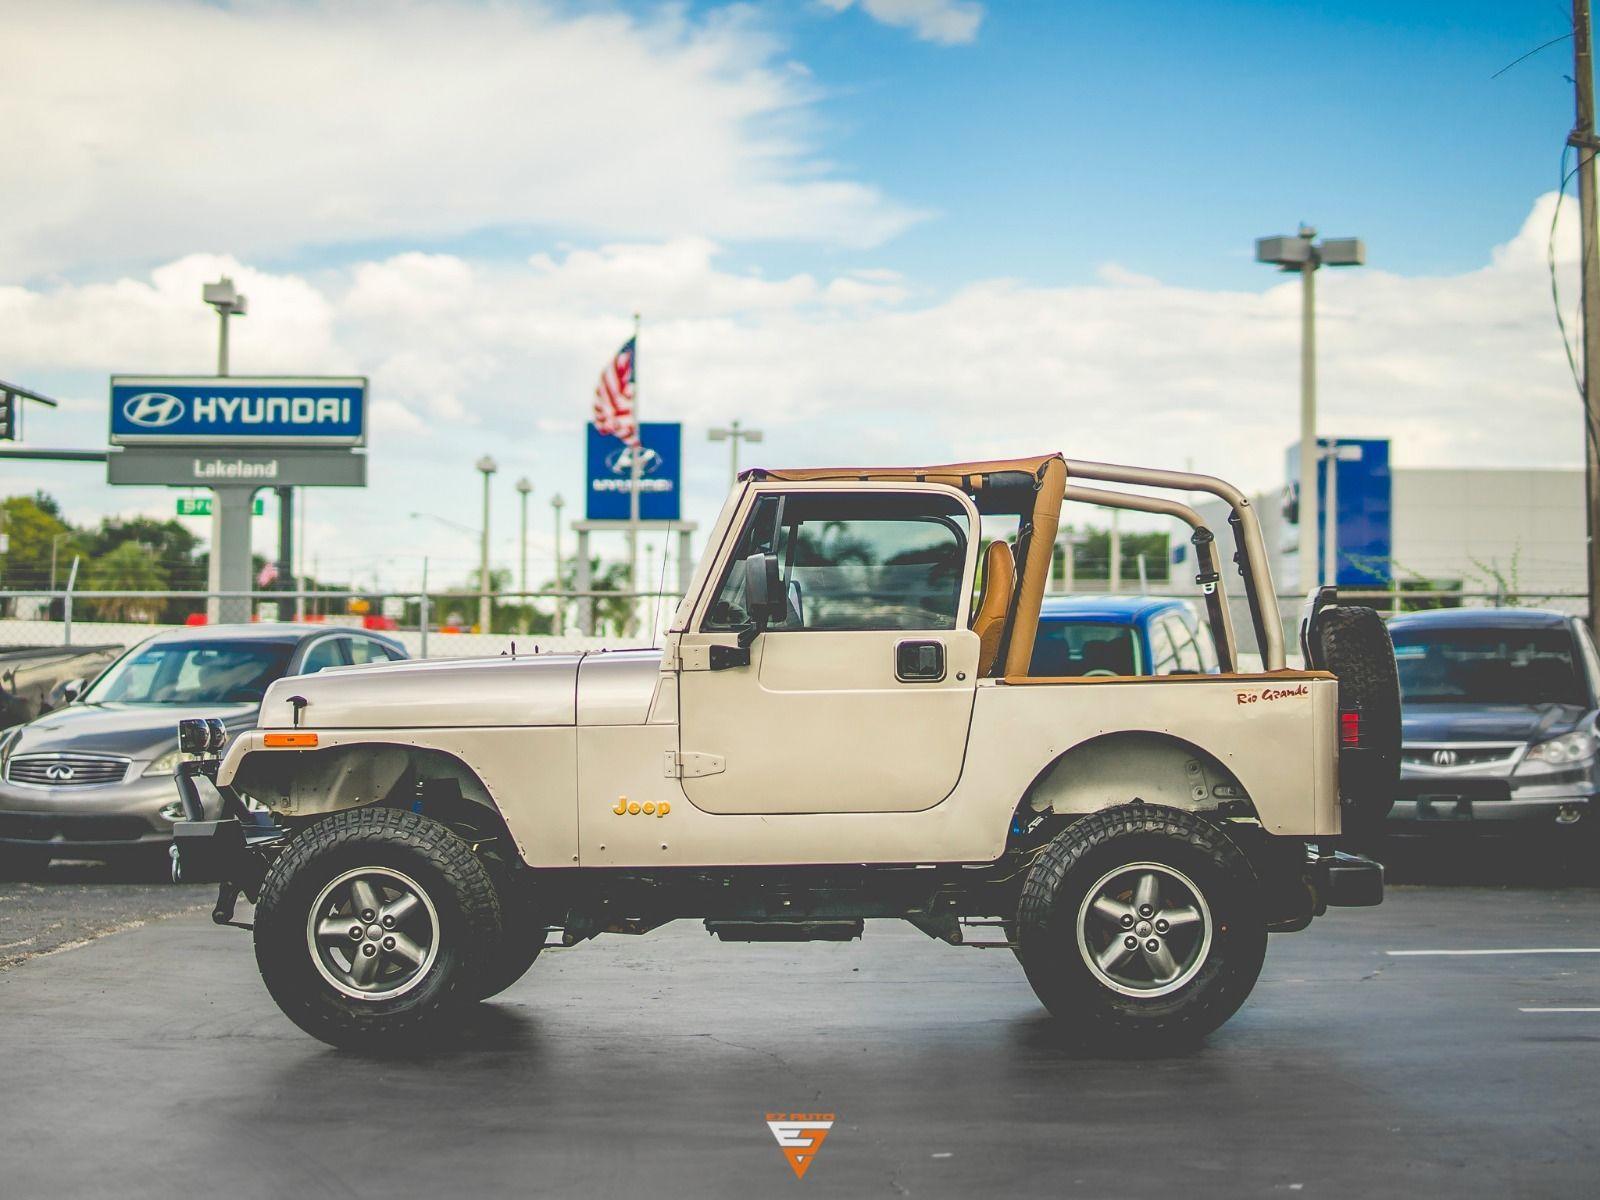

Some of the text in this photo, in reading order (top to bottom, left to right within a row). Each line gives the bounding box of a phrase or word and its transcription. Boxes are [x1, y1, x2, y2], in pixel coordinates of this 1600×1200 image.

[193, 397, 350, 424] HYUNDAI
[193, 459, 278, 478] Lakeland
[1236, 684, 1309, 705] Rio Grande
[612, 795, 671, 818] Jeep
